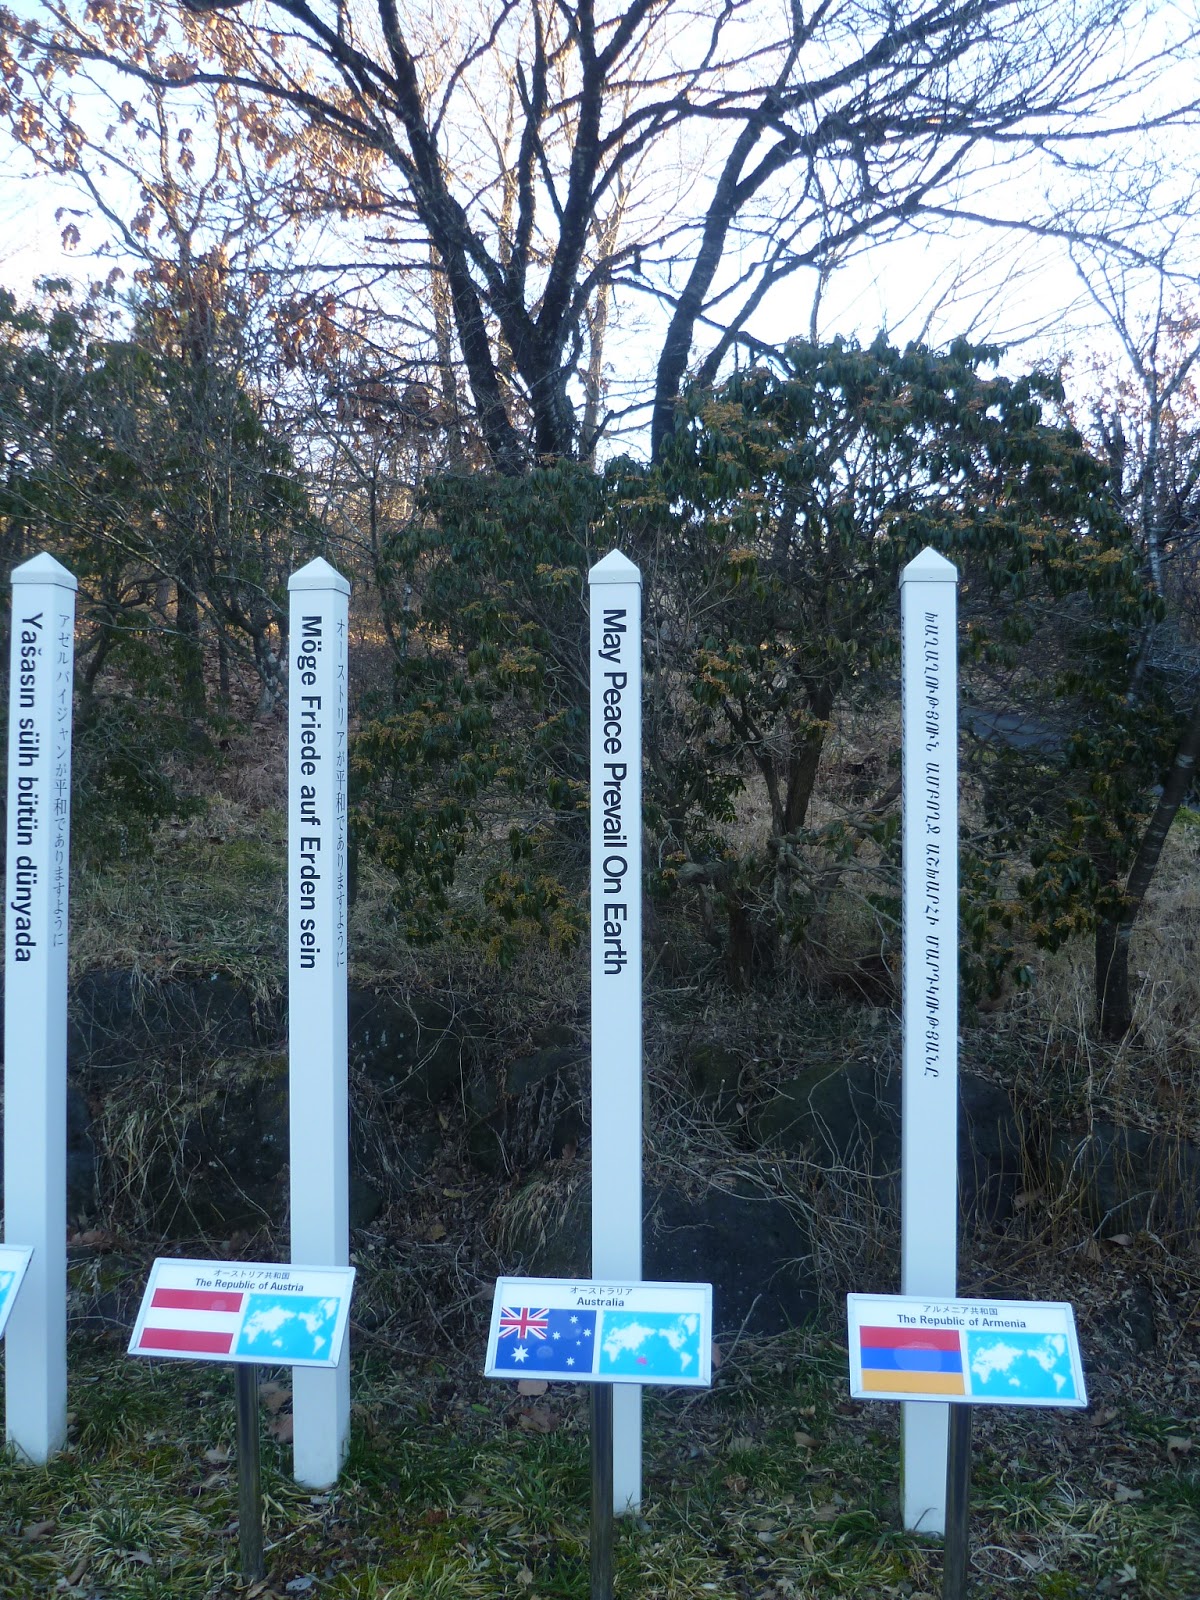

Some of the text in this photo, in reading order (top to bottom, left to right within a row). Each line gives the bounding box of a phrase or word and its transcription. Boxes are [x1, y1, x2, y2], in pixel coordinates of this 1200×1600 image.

[11, 612, 43, 962] Yašasın sülh bütün dünyada
[53, 614, 70, 947] アゼルバイジャンが平和でありますように
[297, 616, 322, 969] Möge Friede auf Erden sein
[335, 619, 346, 968] オーストリアが平和でありますように
[598, 609, 628, 975] May Peace Prevail On Earth
[213, 1269, 290, 1281] オーストリア共和国
[195, 1278, 304, 1292] The Republic of Austria
[570, 1286, 633, 1296] オーストラリア
[577, 1297, 624, 1307] Australia
[923, 1305, 998, 1316] アルメニア共和国
[897, 1314, 1026, 1329] The Republic of Armenia
